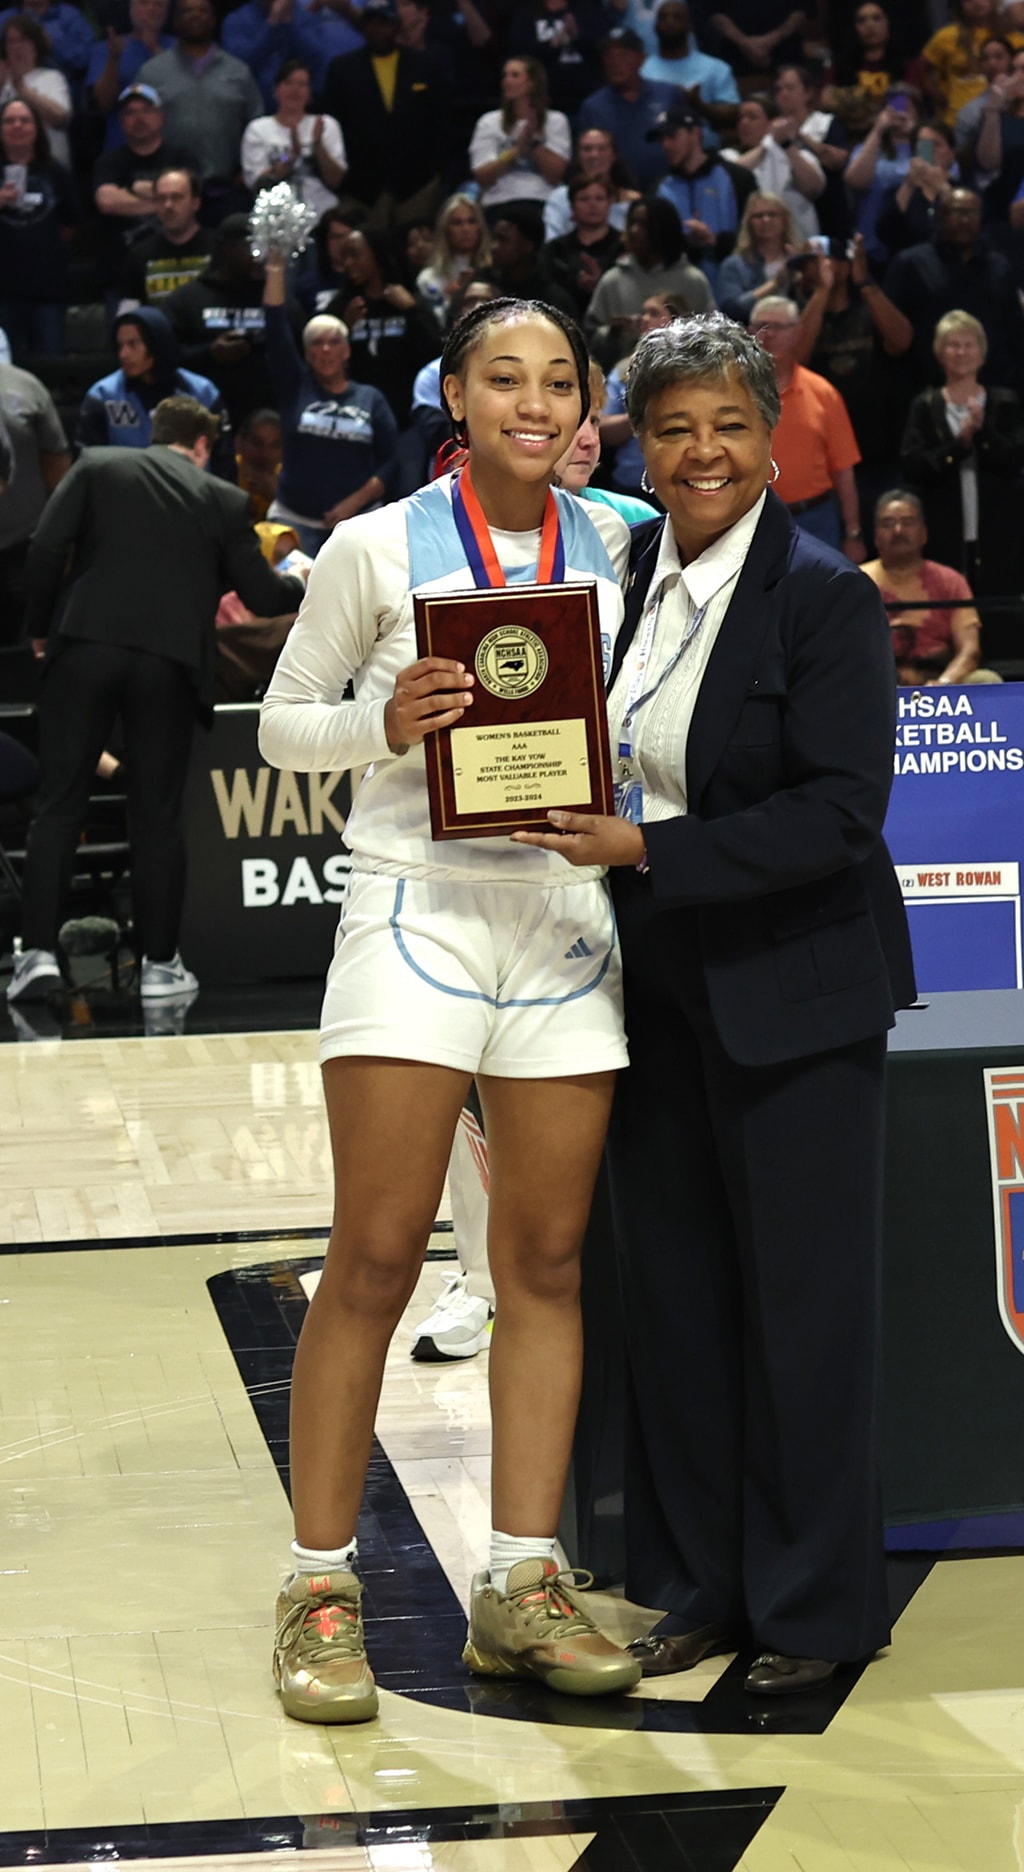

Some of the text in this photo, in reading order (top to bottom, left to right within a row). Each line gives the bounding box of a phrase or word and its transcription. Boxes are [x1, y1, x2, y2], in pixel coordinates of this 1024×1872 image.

[495, 647, 527, 658] NCHSAA
[476, 728, 561, 741] WOMEN'S BASKETBALL
[512, 754, 527, 762] KAY
[480, 761, 562, 774] STATE CHAMPIONSHIP
[476, 769, 568, 783] MOST VALUABLE PLAYER
[505, 793, 542, 803] 2023-2024
[902, 871, 1001, 888] (2) WEST ROWAN
